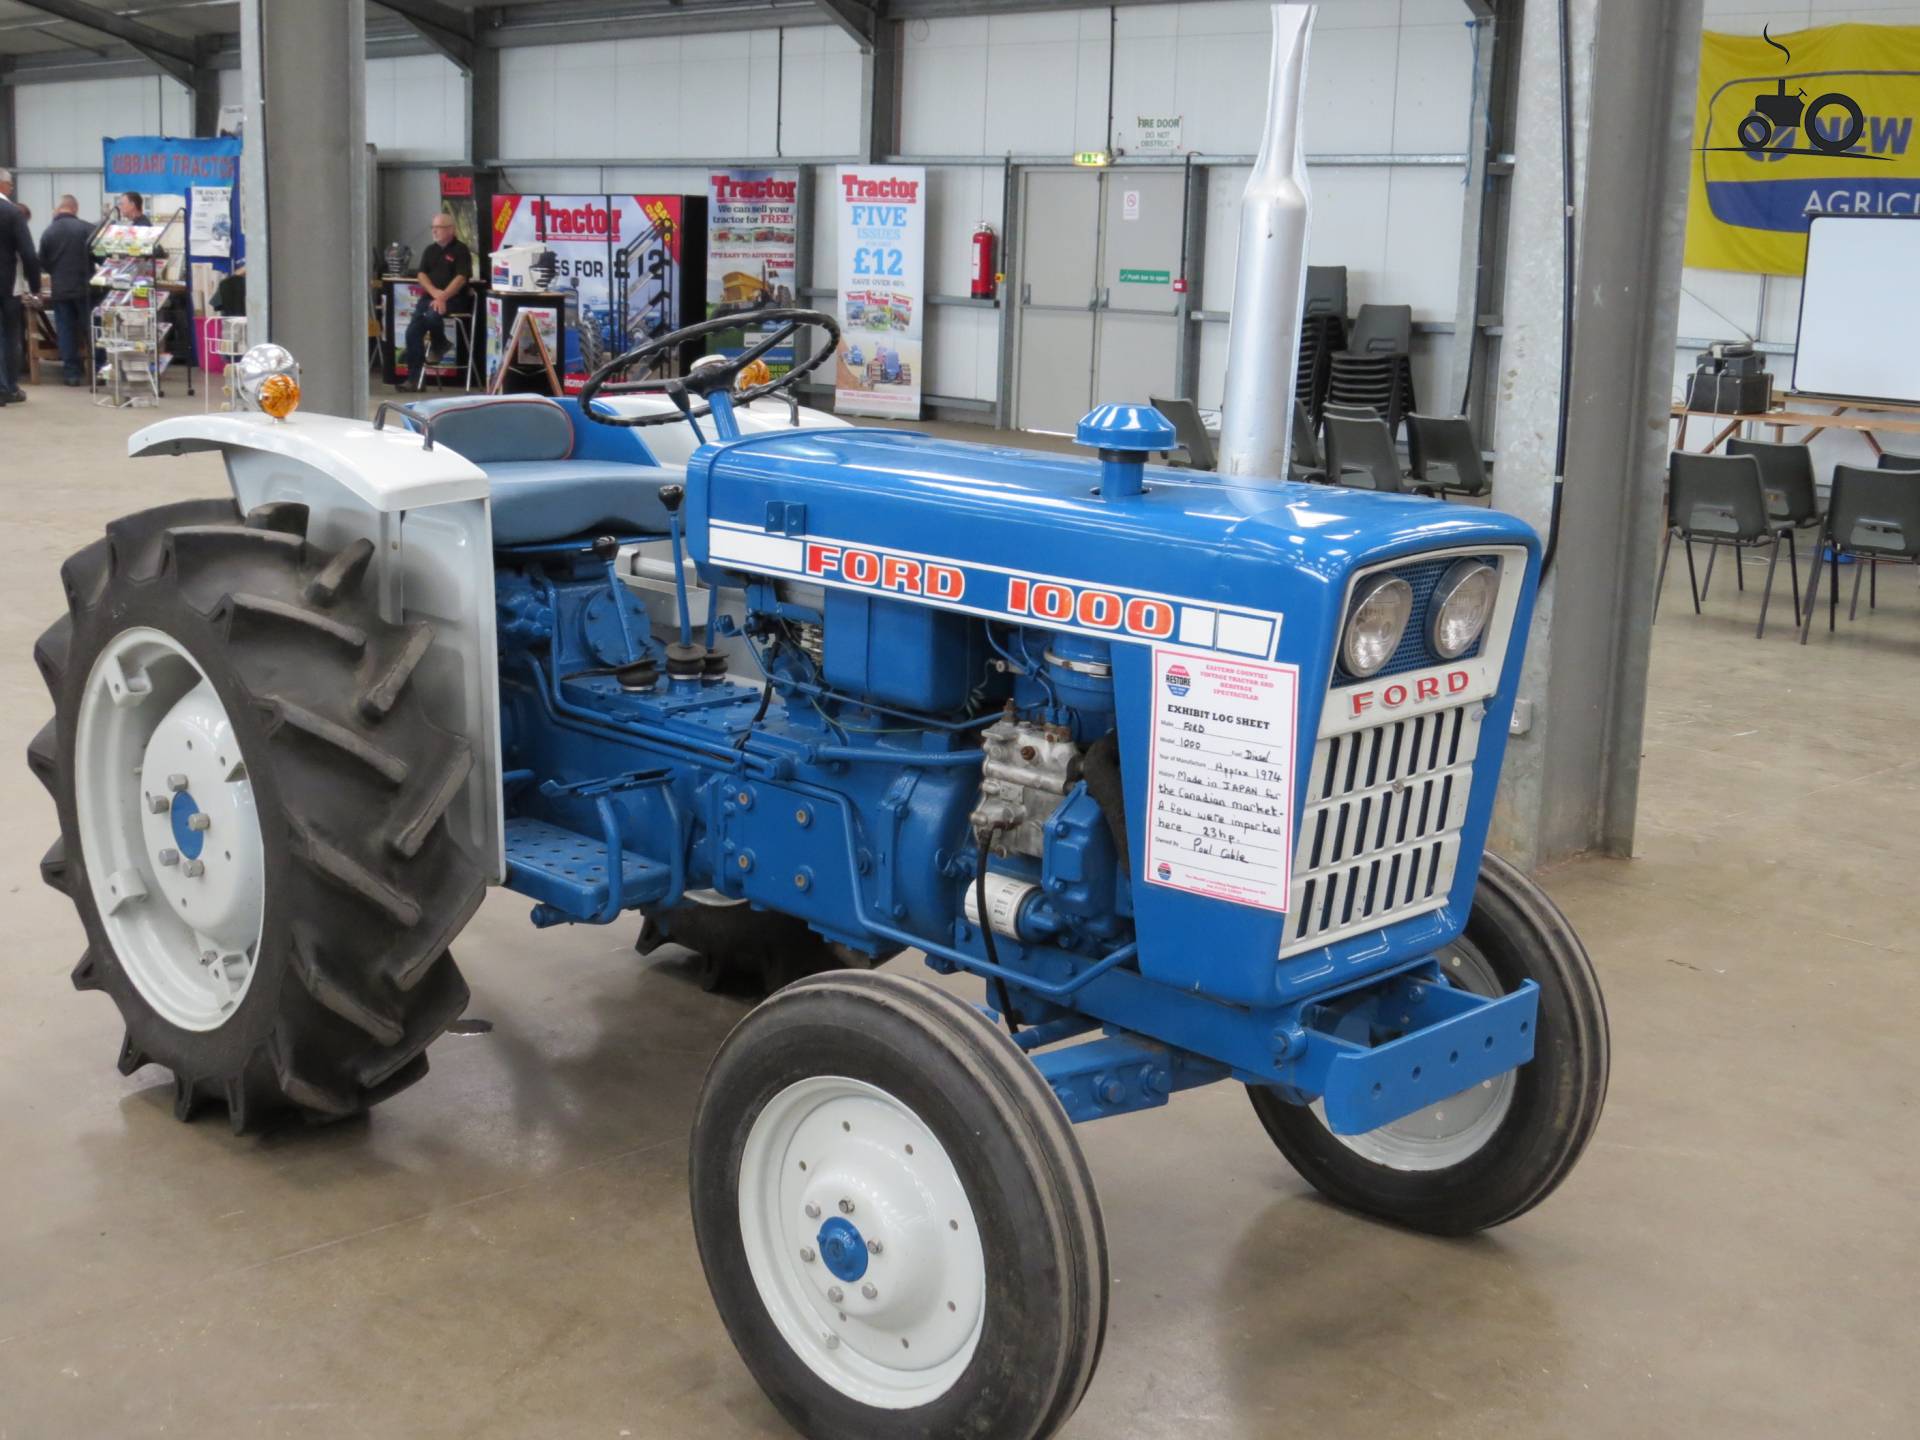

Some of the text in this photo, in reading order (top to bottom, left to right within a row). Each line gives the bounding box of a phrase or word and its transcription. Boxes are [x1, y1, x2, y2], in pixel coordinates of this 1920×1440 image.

[1138, 119, 1180, 128] FIRE DOOR
[711, 175, 796, 198] Tractor
[842, 174, 919, 198] Tractor
[531, 200, 622, 234] Tractor
[713, 215, 794, 224] tractor for FREE!
[718, 205, 732, 213] We
[752, 204, 767, 213] sell
[769, 206, 790, 215] your
[851, 205, 907, 227] FIVE
[575, 260, 604, 278] FOR
[854, 247, 903, 276] £12
[806, 542, 1175, 639] FORD 1000
[1165, 674, 1191, 688] RESTORE
[1351, 671, 1469, 715] FORD
[1167, 704, 1270, 730] EXHIBIT LOG SHEET
[1180, 737, 1201, 749] 1000
[1178, 771, 1203, 785] Made
[1207, 777, 1217, 788] in
[1222, 781, 1258, 796] JAPAN
[1255, 768, 1282, 782] 1974
[1159, 784, 1175, 795] the
[1178, 787, 1226, 807] Canadian
[1158, 800, 1281, 836] A few were imported
[1158, 818, 1182, 832] here
